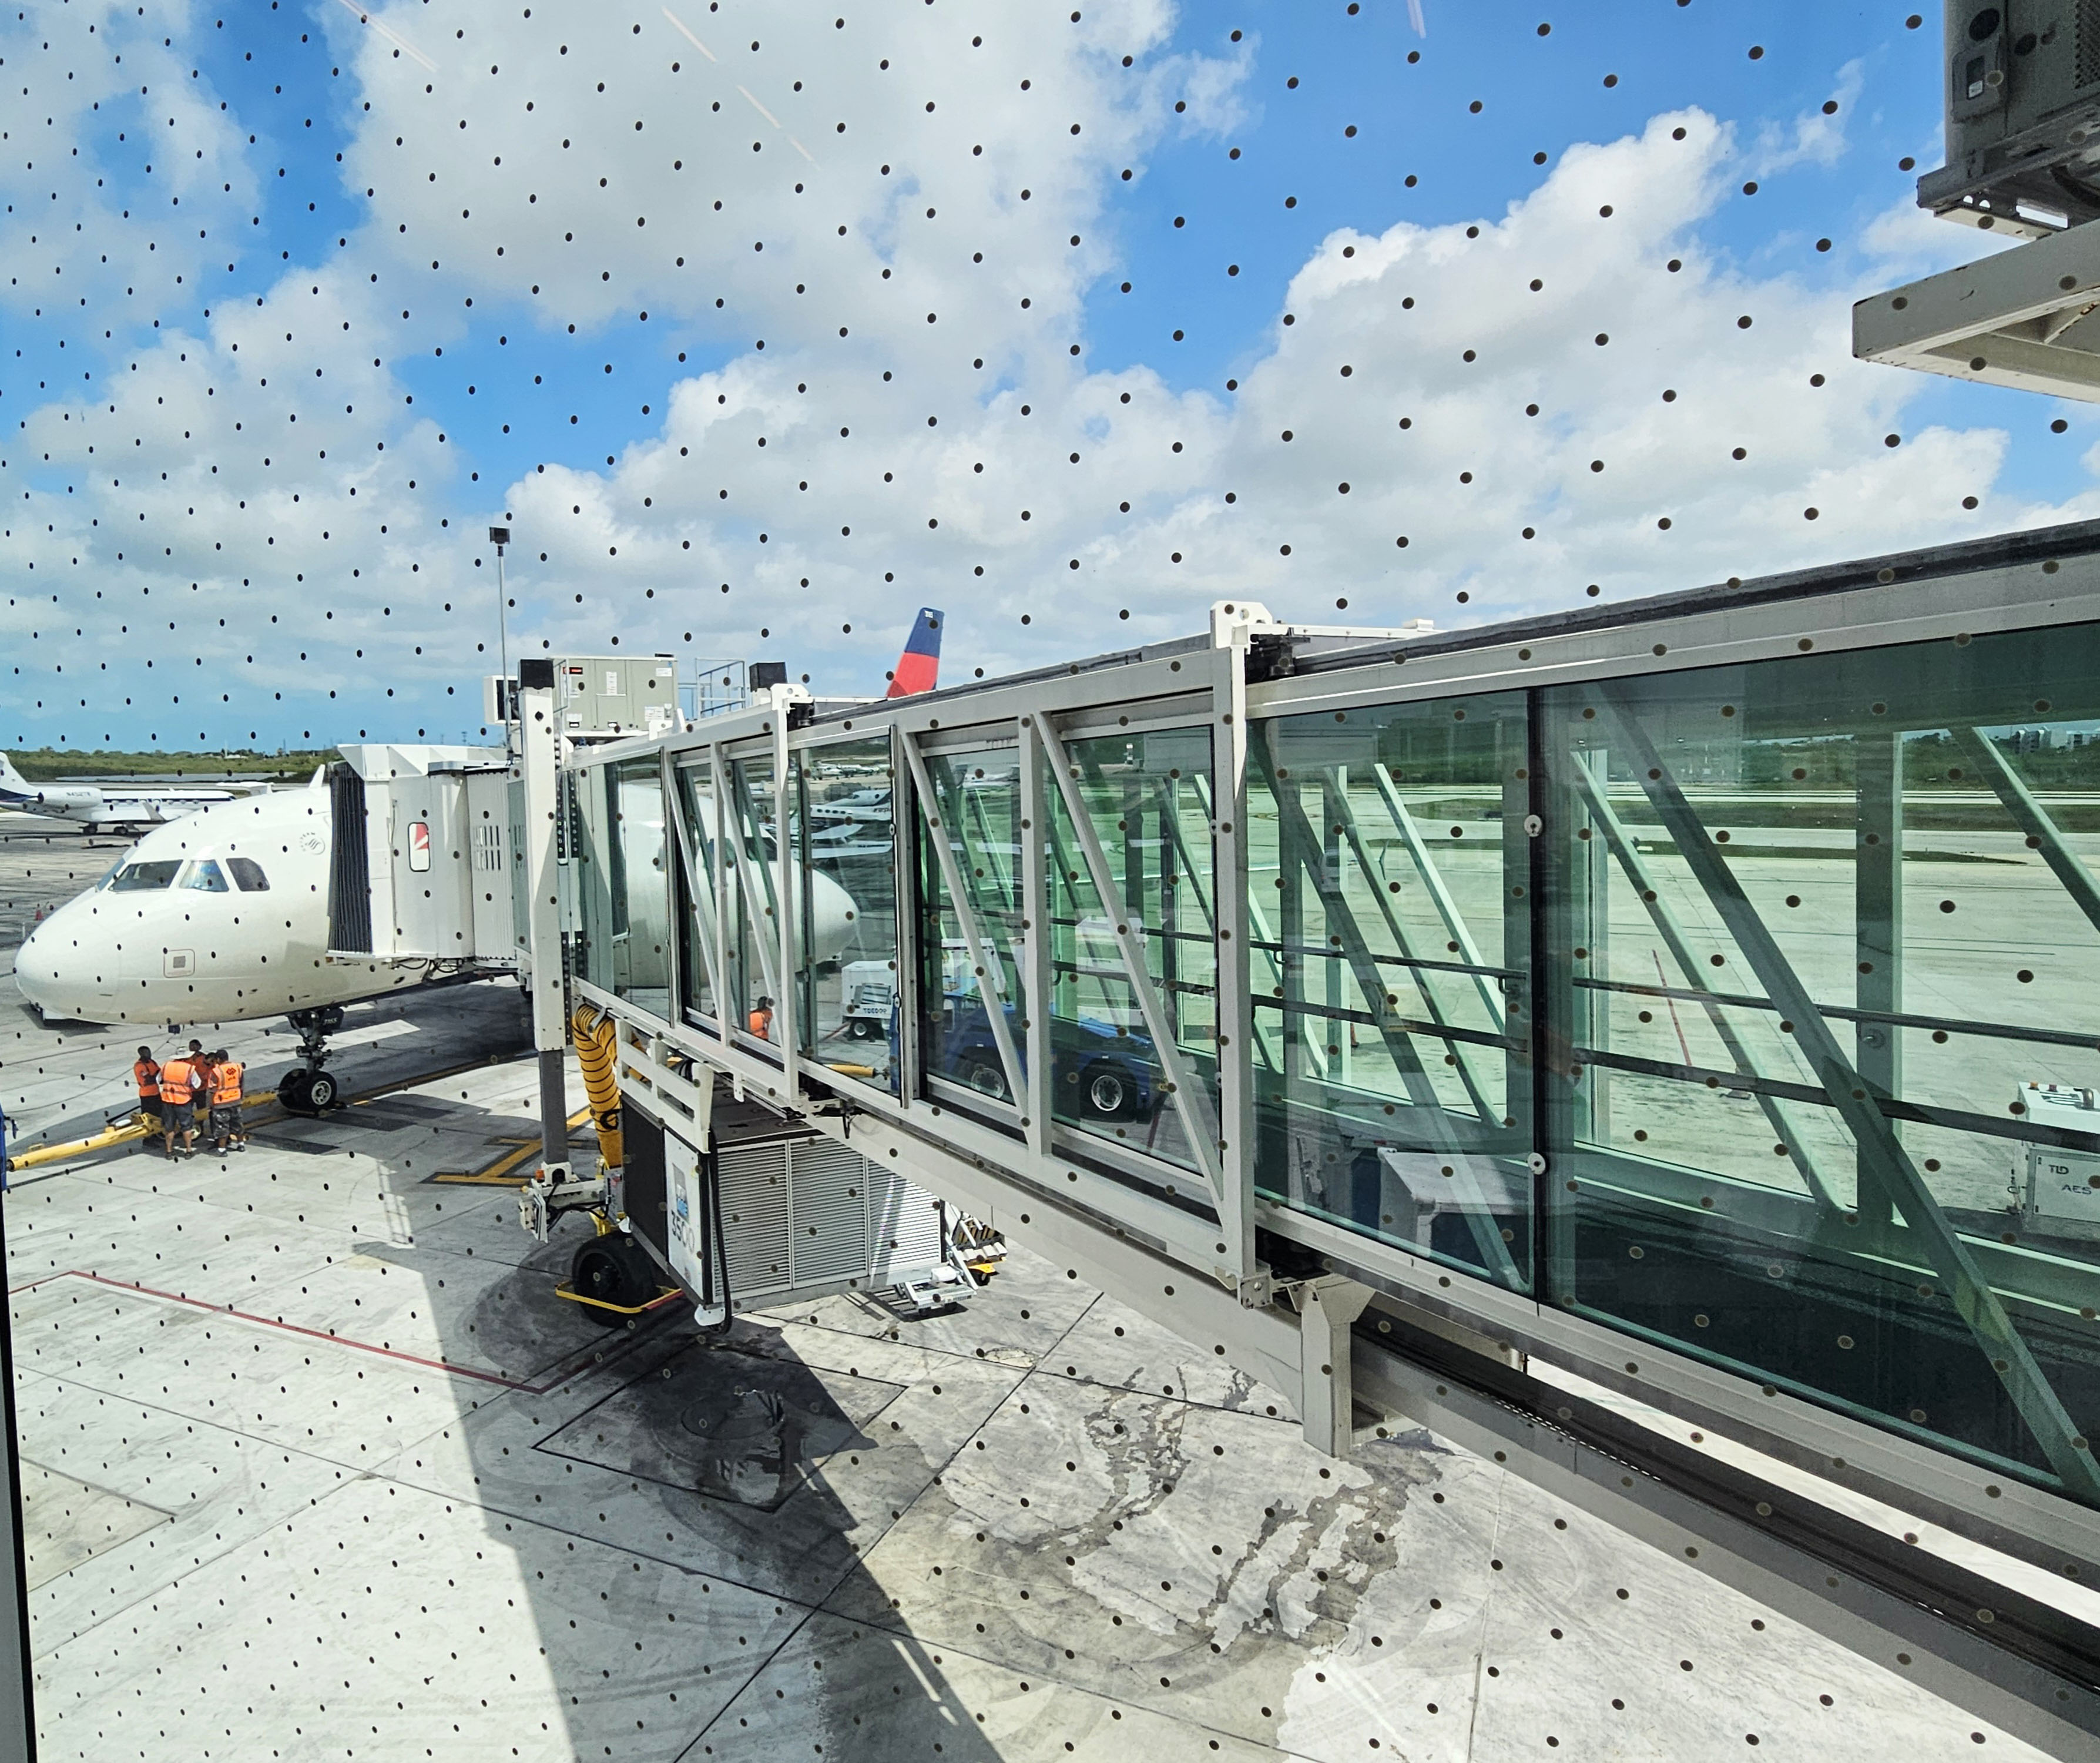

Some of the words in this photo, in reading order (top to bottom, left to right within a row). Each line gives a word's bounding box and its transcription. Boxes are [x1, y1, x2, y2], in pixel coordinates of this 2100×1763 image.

[2048, 1164, 2069, 1175] TLD
[2061, 1184, 2092, 1195] AES
[671, 1209, 695, 1255] 3500
